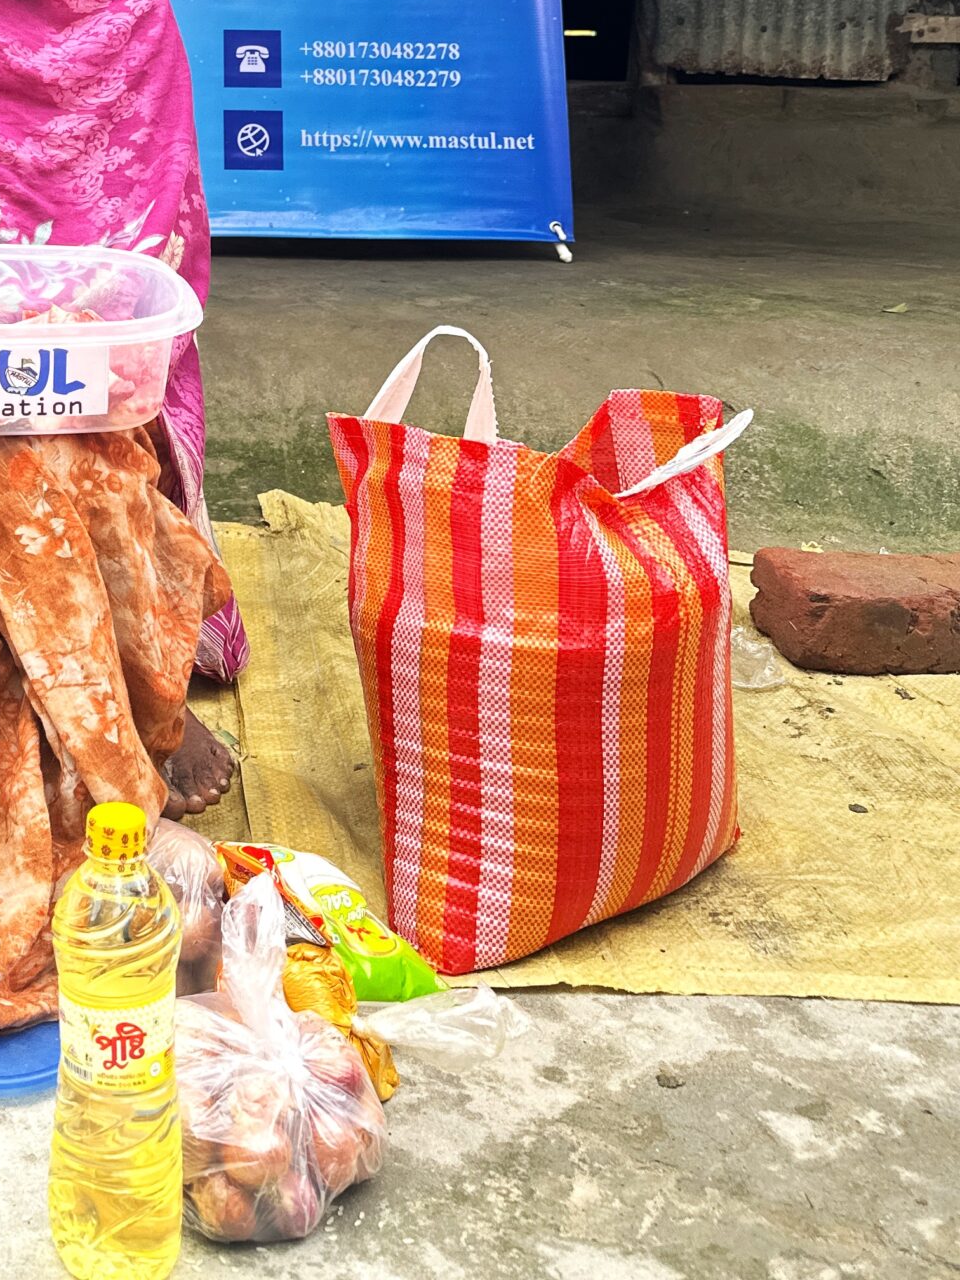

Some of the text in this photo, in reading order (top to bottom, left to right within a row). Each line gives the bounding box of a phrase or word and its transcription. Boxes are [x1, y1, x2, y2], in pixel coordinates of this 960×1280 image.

[299, 41, 461, 60] +8801730482278
[300, 68, 462, 88] +8801730482279
[301, 129, 536, 152] https://www.mastul.net
[95, 1022, 148, 1070] পুষ্টি
